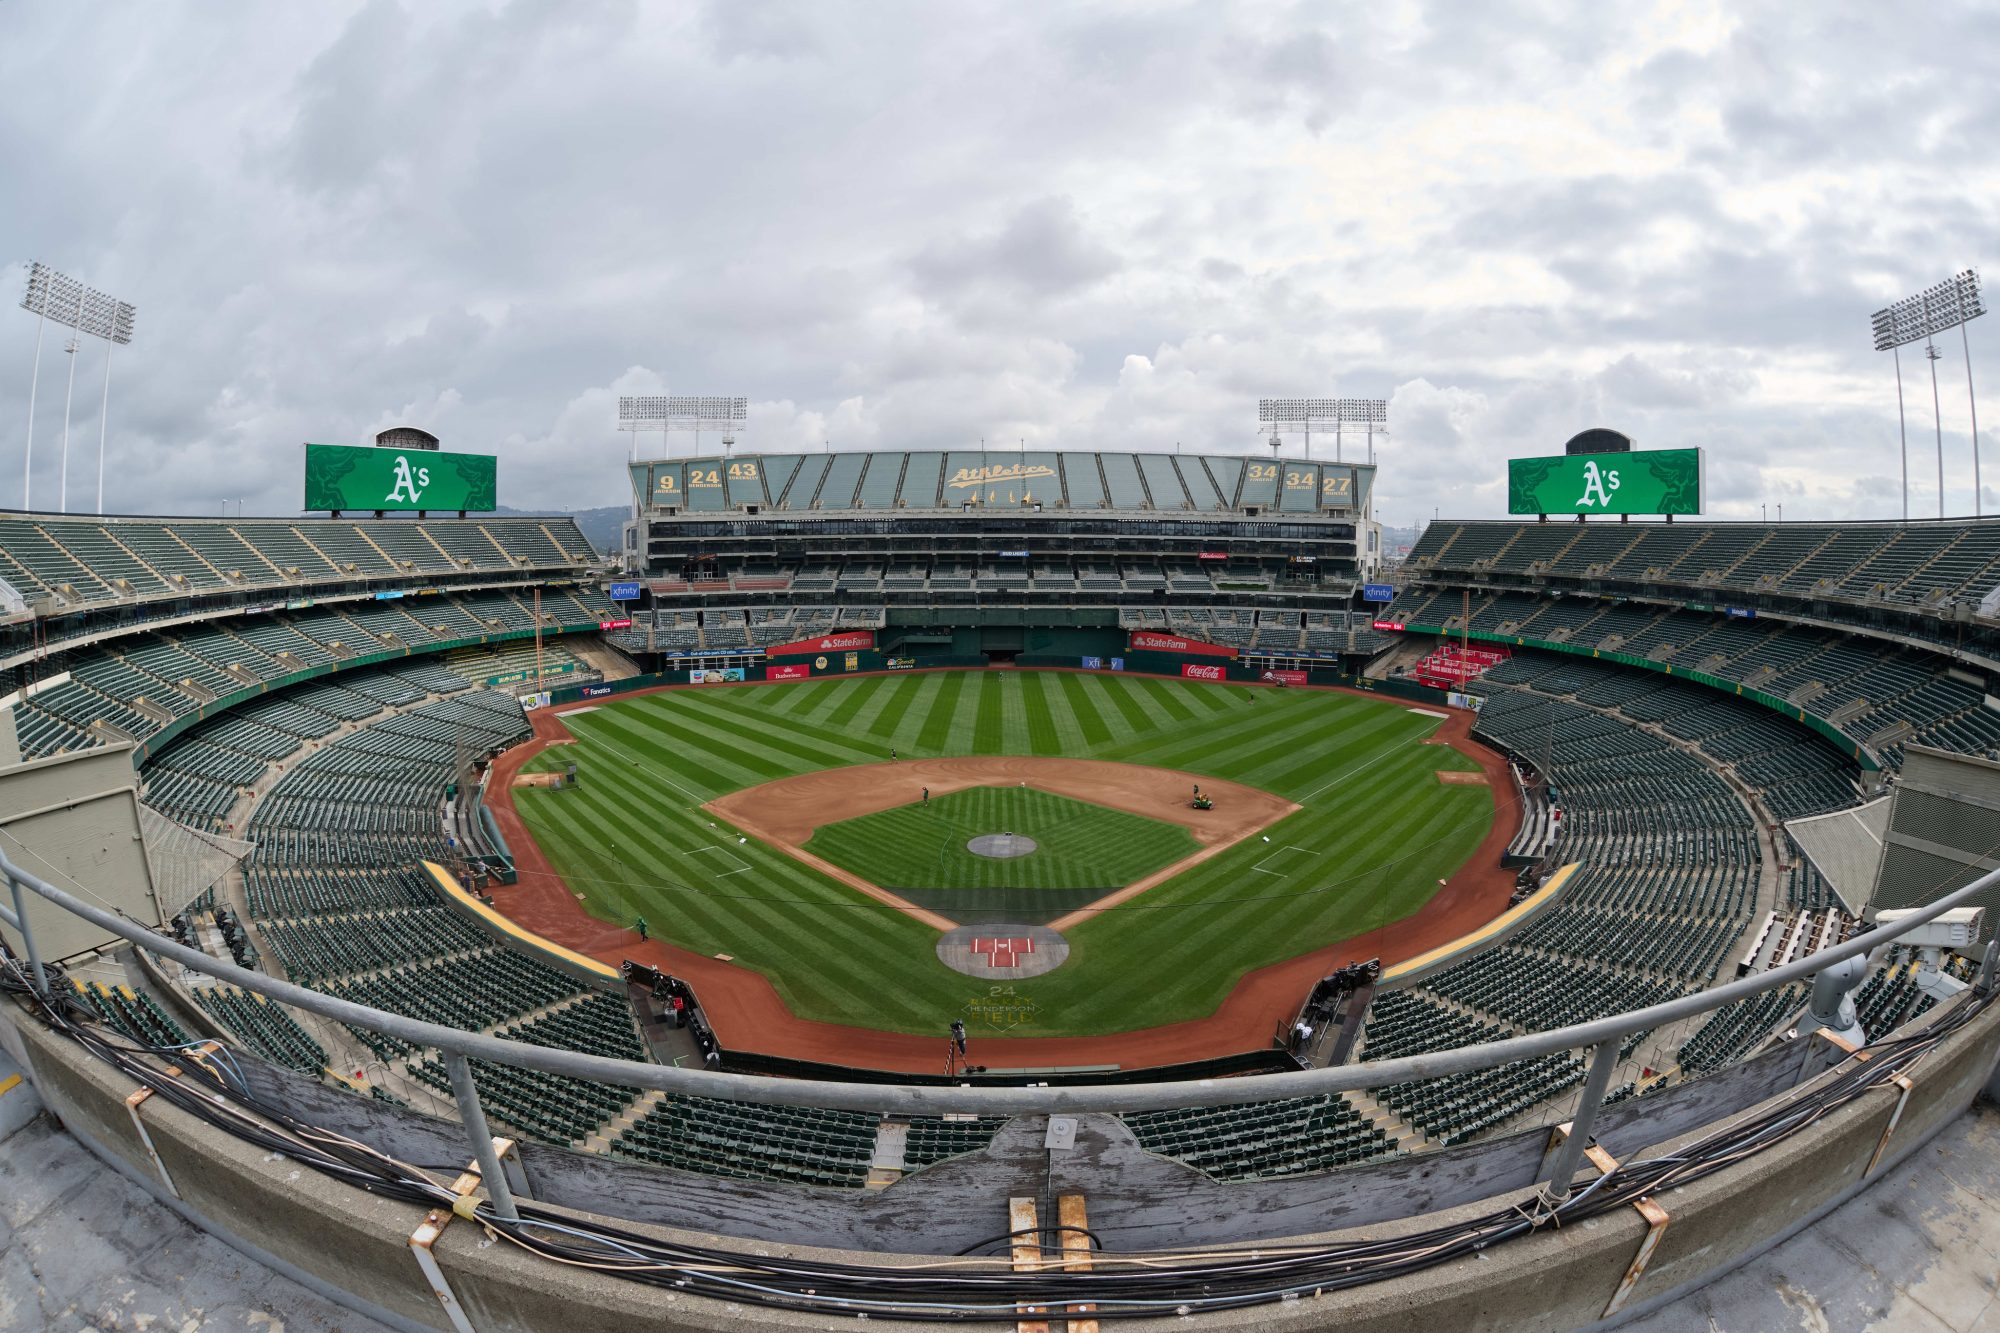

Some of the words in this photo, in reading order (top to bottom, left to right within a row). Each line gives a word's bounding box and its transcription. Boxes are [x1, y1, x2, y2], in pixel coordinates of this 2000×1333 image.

[691, 470, 719, 484] 24
[729, 463, 756, 477] 43
[947, 464, 1055, 488] Athletics
[1249, 465, 1277, 478] 34
[385, 455, 430, 503] A's
[660, 475, 674, 489] 9
[1286, 472, 1314, 486] 34
[1323, 477, 1351, 492] 27
[1576, 461, 1620, 507] A's
[613, 587, 637, 597] xfinity
[1366, 588, 1391, 598] xfinity
[590, 687, 611, 696] Fanatics
[989, 986, 1016, 997] 24
[971, 1012, 1034, 1024] FIELD
